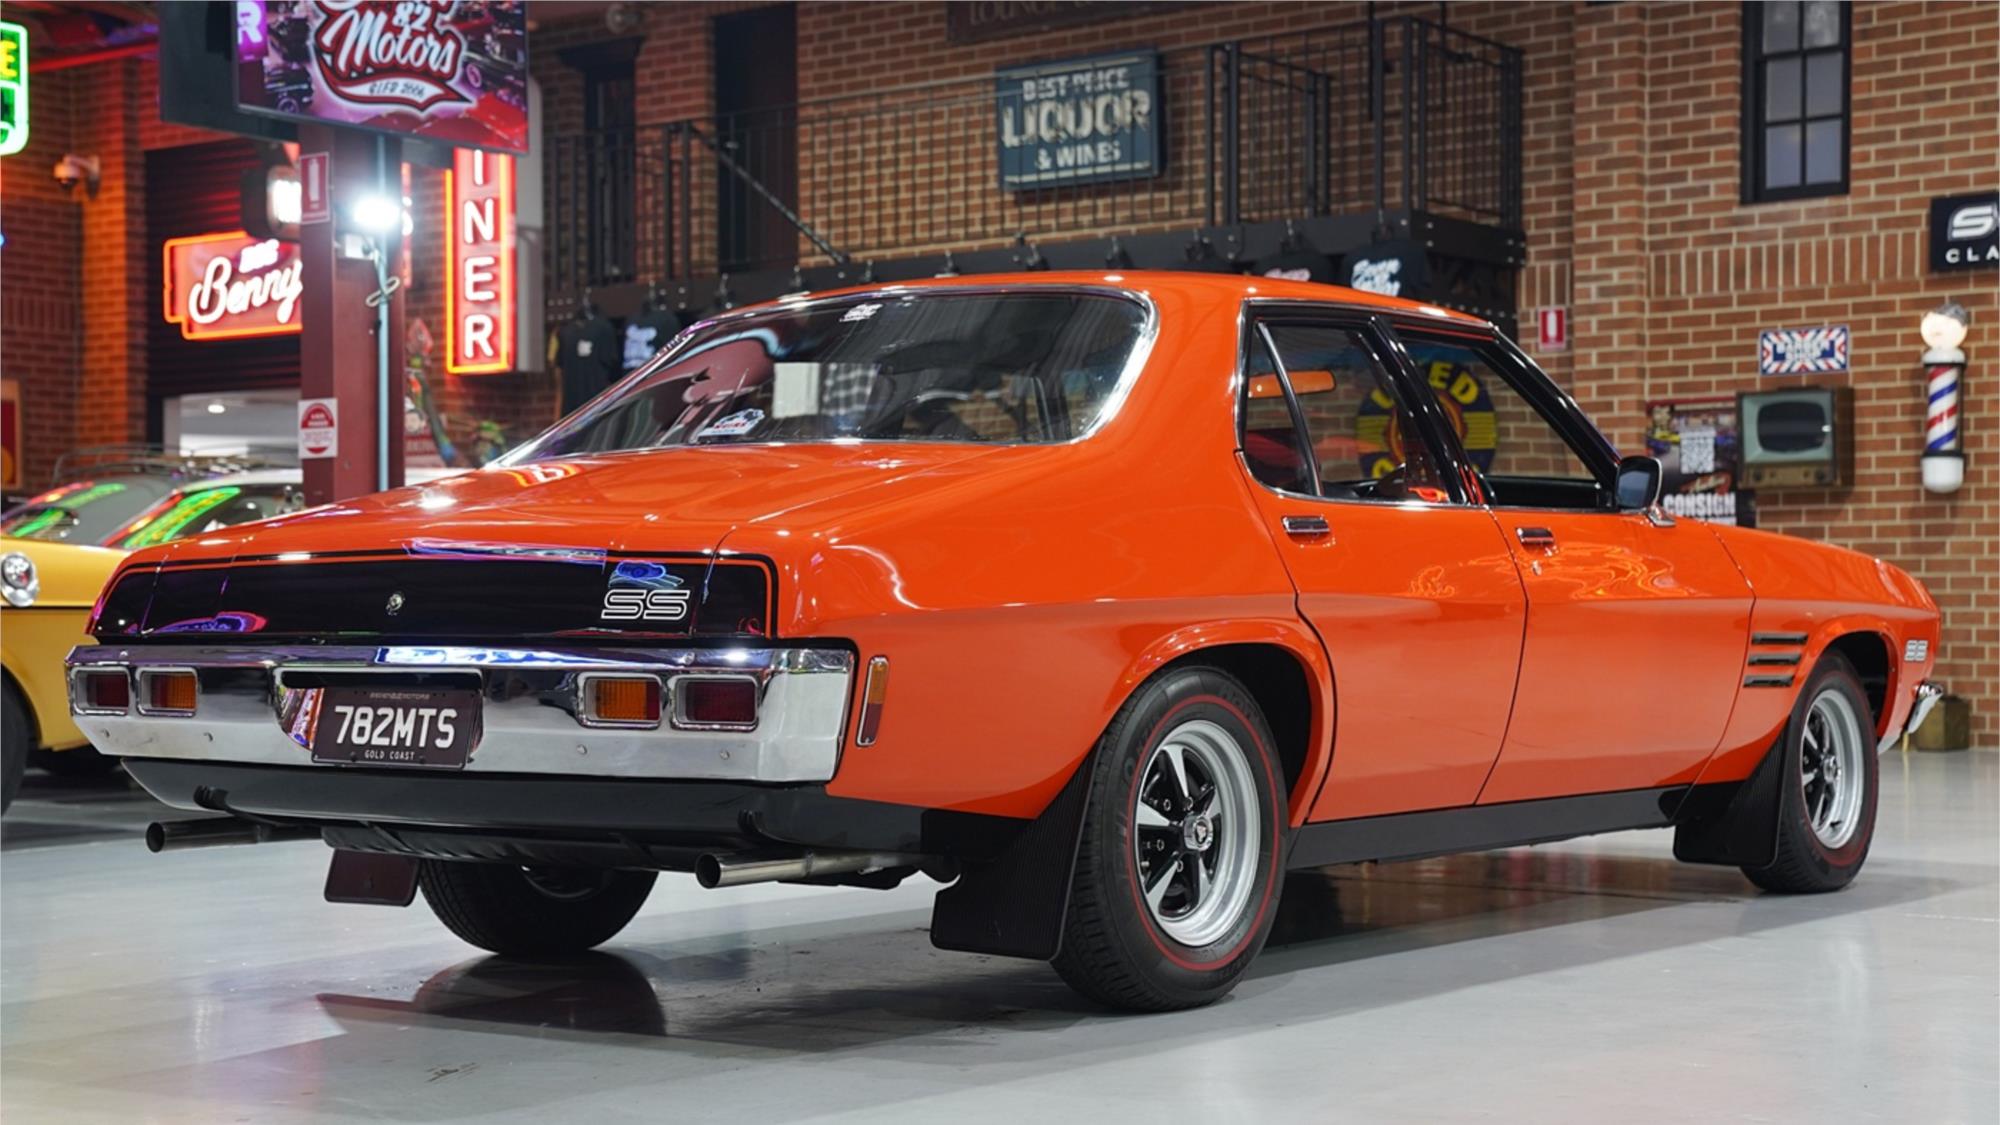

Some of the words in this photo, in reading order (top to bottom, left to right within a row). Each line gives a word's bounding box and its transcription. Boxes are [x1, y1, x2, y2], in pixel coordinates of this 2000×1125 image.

[321, 9, 456, 72] Motors
[1022, 75, 1070, 101] BEST
[1072, 67, 1129, 94] PRICE
[1002, 89, 1151, 148] LIQUOR
[1035, 147, 1052, 170] &
[1056, 140, 1121, 167] WINES
[188, 256, 303, 324] Benny
[1663, 491, 1736, 518] CONSIGN
[601, 589, 690, 620] SS
[334, 705, 457, 749] 782MTS
[364, 750, 385, 760] GOLD
[389, 751, 415, 761] COAST
